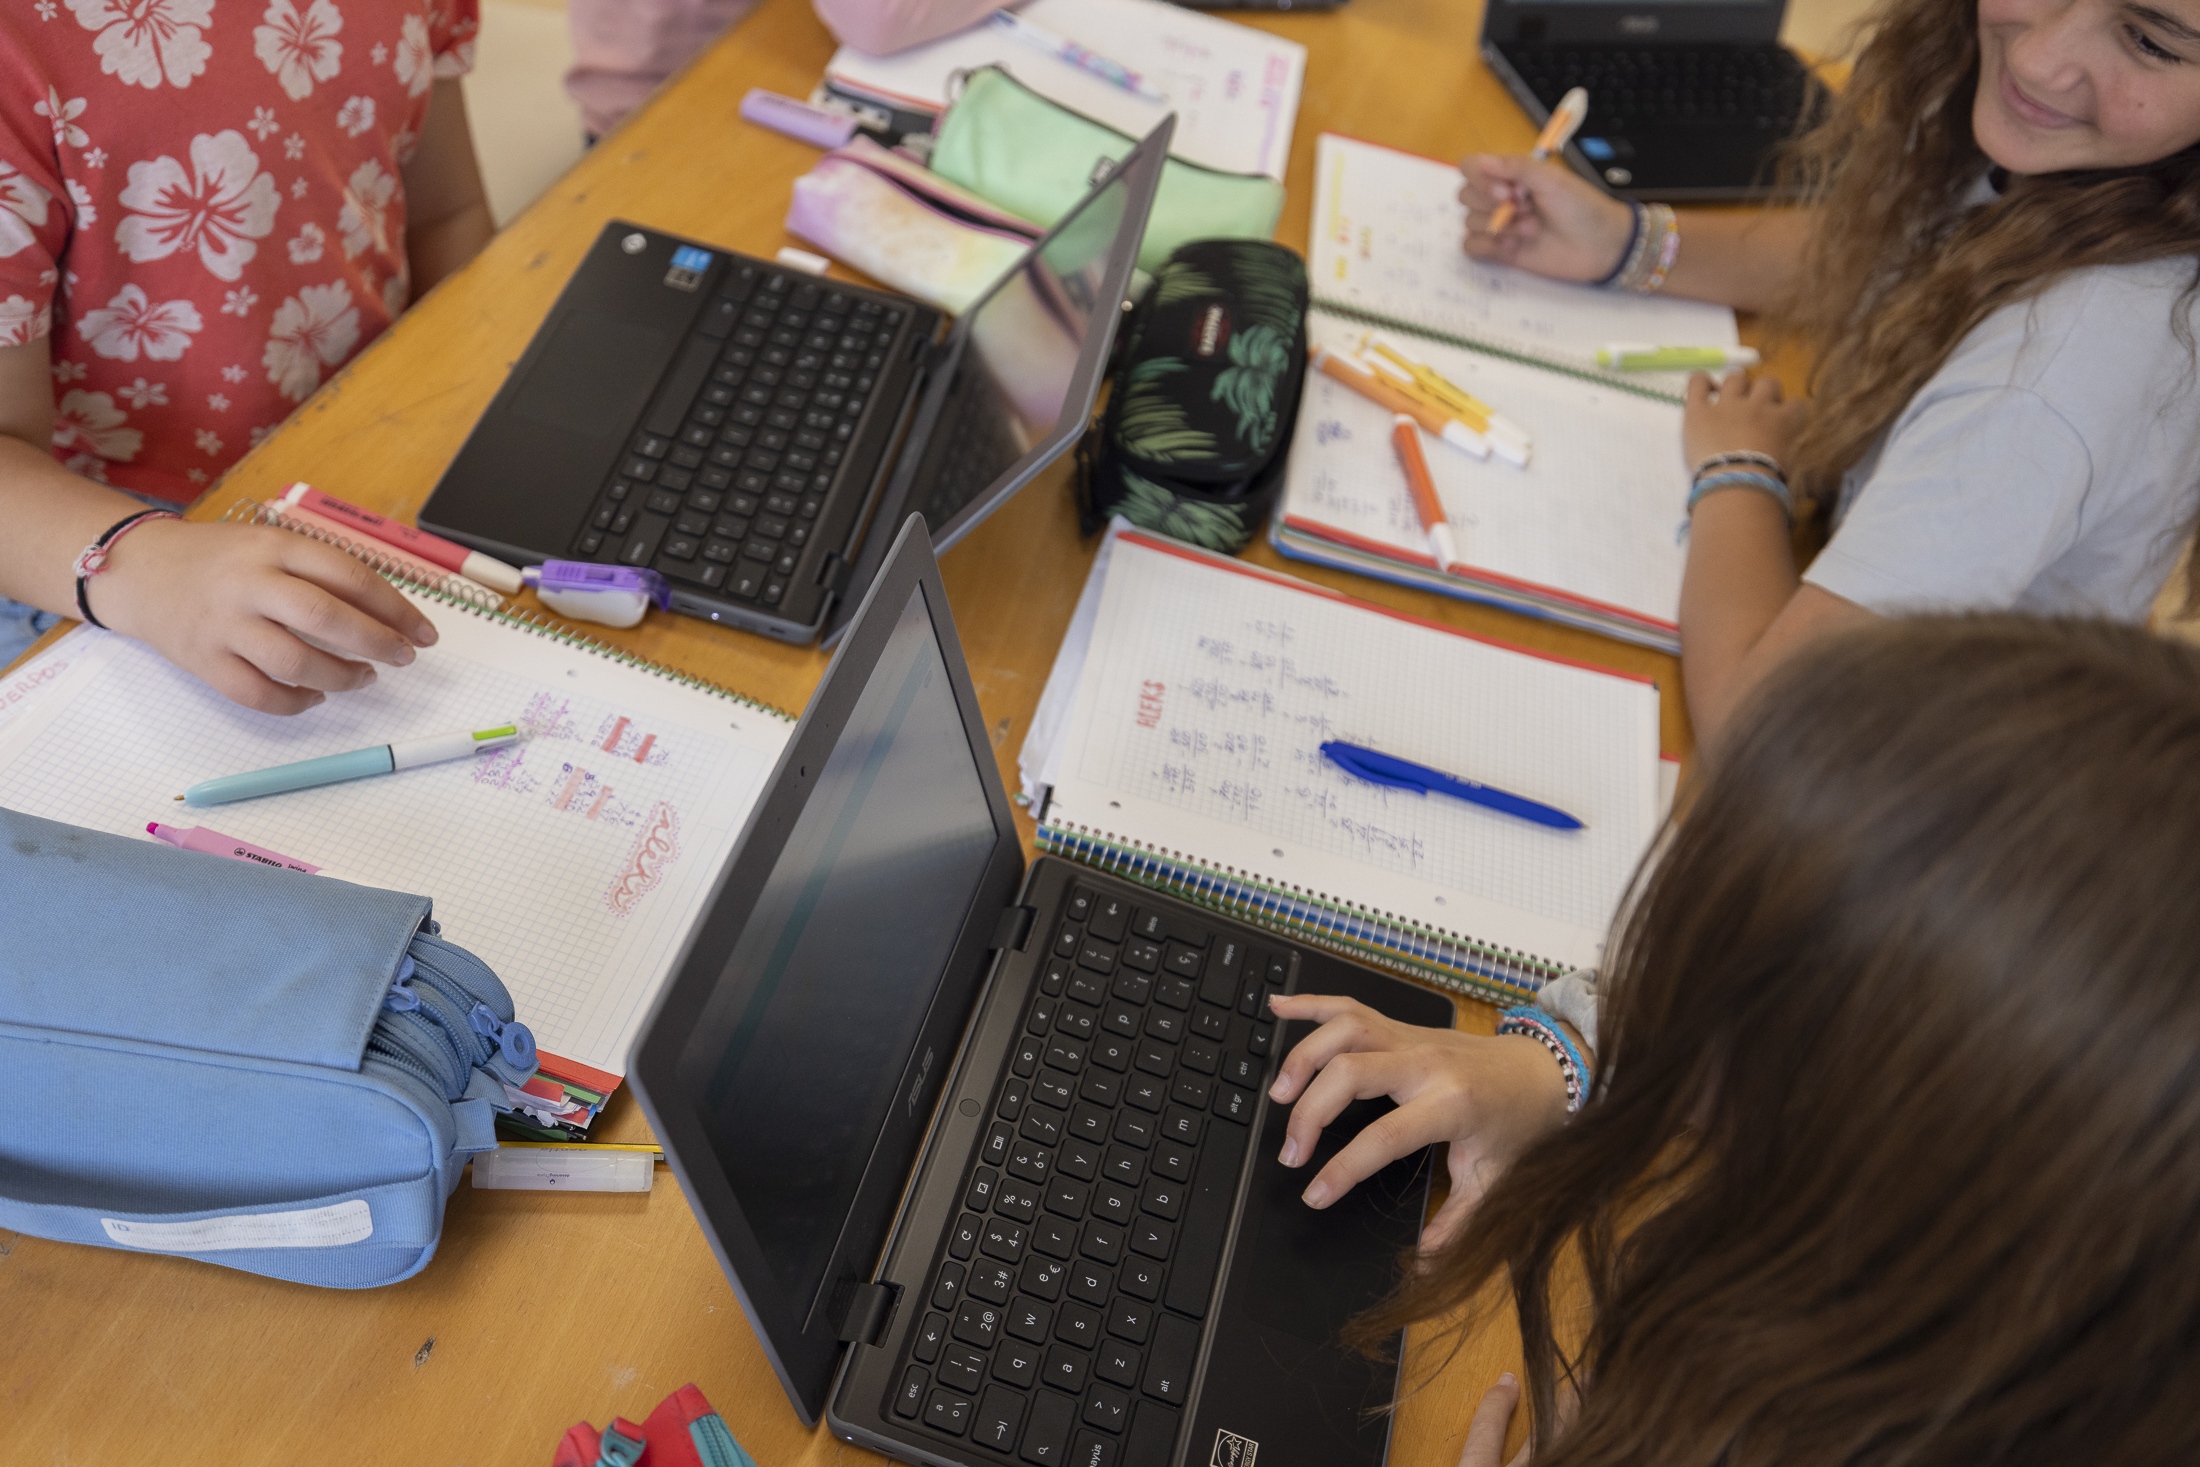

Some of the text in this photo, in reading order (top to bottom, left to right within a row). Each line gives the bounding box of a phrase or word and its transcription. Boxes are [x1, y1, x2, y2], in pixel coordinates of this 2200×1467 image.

[1135, 679, 1167, 729] ALEKS
[246, 852, 282, 868] STABILO
[1148, 917, 1157, 931] intro
[1119, 1015, 1129, 1024] p
[1159, 1020, 1170, 1028] ñ
[1240, 1062, 1248, 1075] ctrl
[908, 1046, 933, 1118] ASUS
[1234, 1094, 1241, 1103] gr
[1045, 1123, 1055, 1131] 7
[1087, 1119, 1096, 1127] u
[1179, 1119, 1189, 1131] m
[1075, 1155, 1086, 1164] y
[1169, 1157, 1178, 1165] n
[1119, 1161, 1131, 1169] h
[1004, 1195, 1015, 1204] %
[1021, 1199, 1031, 1207] 5
[1109, 1198, 1120, 1207] g
[1156, 1195, 1168, 1203] b
[111, 1222, 130, 1232] ID
[1039, 1274, 1048, 1282] e
[1086, 1277, 1097, 1287] d
[1138, 1274, 1147, 1282] c
[1025, 1313, 1036, 1324] w
[1127, 1316, 1136, 1324] x
[1075, 1321, 1085, 1329] s
[1013, 1359, 1026, 1368] q
[1115, 1359, 1125, 1367] z
[1063, 1364, 1072, 1372] a
[908, 1383, 918, 1398] esc
[1161, 1380, 1169, 1392] alt
